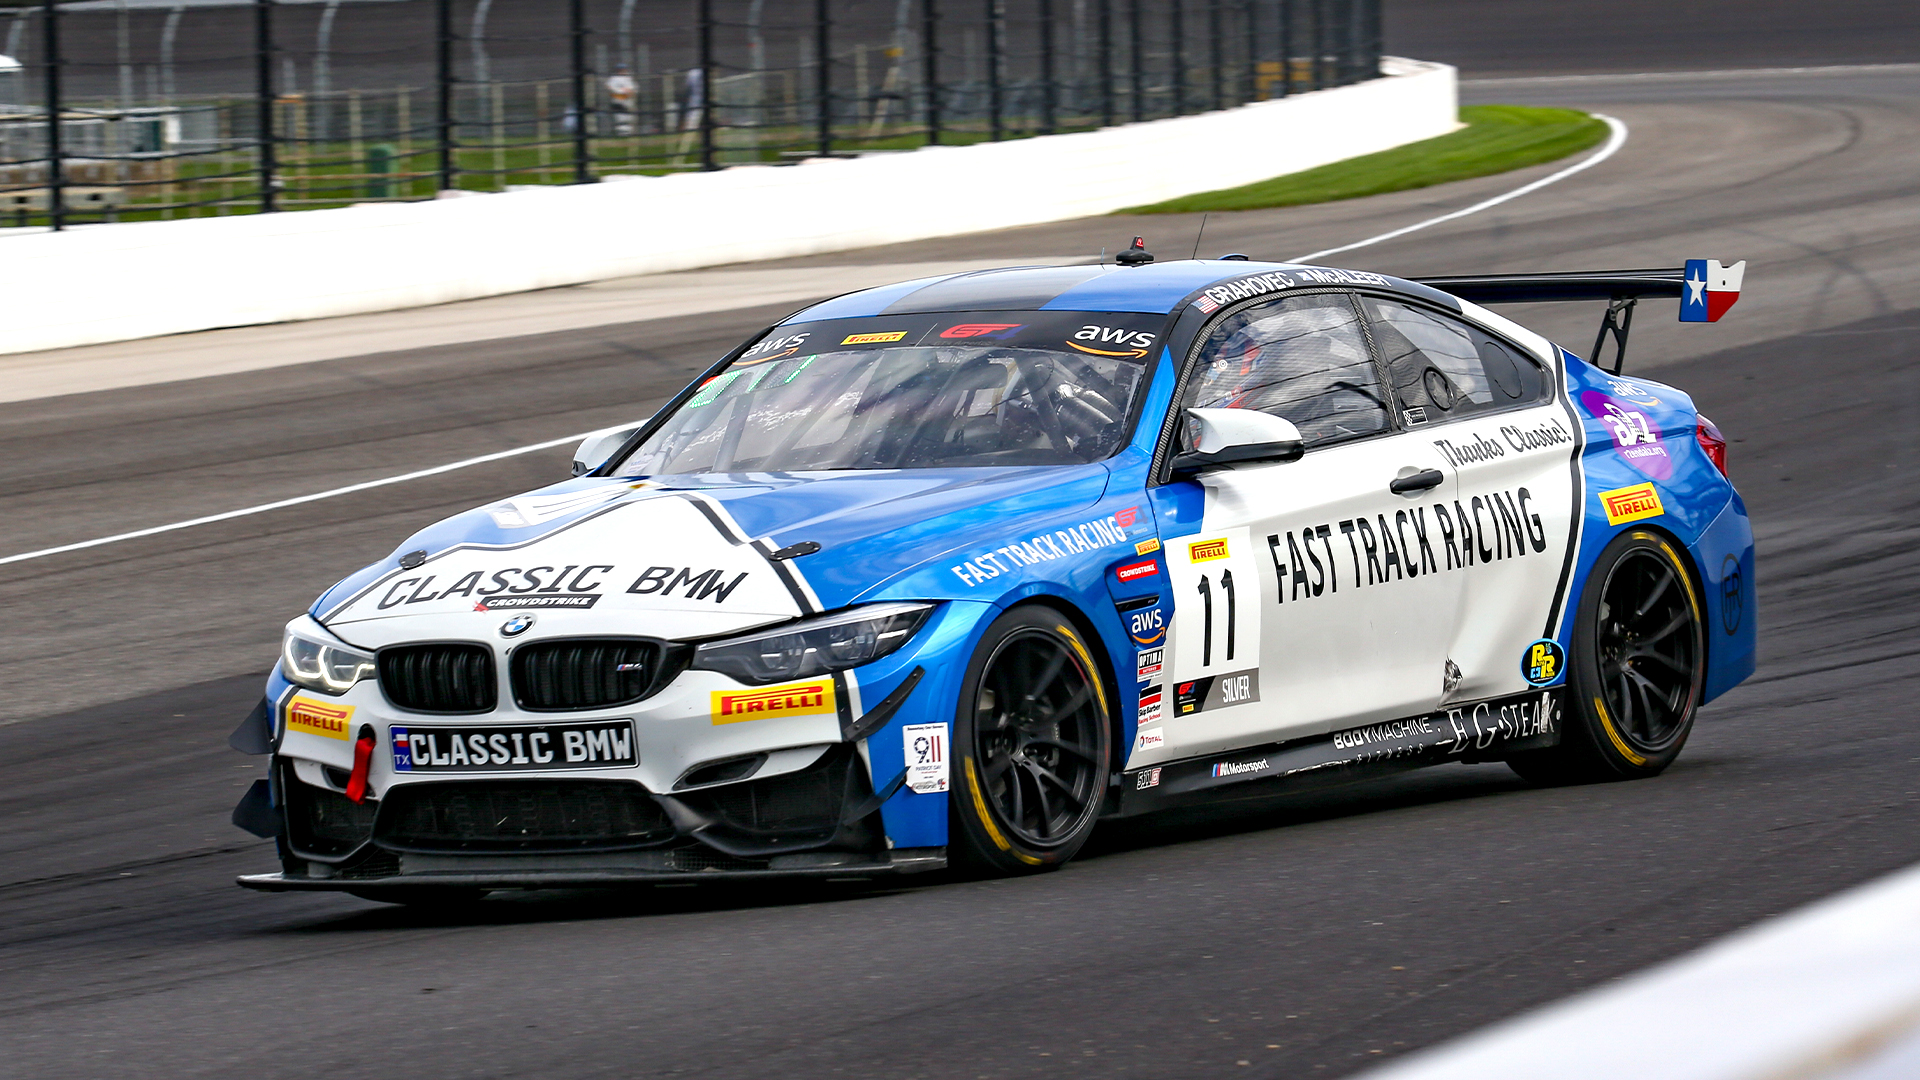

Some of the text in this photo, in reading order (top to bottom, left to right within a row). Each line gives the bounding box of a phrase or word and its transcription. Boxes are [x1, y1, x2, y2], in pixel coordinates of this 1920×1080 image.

[1204, 271, 1295, 304] GRAHOVEC
[1306, 269, 1391, 287] McALEER
[741, 332, 811, 358] aws
[848, 333, 900, 343] PIRELLI
[1074, 325, 1156, 348] aws
[1607, 381, 1647, 396] aws
[1433, 418, 1572, 467] Thanks Classic!
[1606, 489, 1657, 517] PIRELLI
[951, 516, 1127, 587] FAST TRACK RACING
[1192, 541, 1226, 560] PIRELLI
[1267, 487, 1547, 604] FAST TRACK RACING
[1120, 564, 1155, 578] CROWDSTRIKE
[377, 565, 749, 610] CLASSIC BMW
[487, 597, 591, 607] CROWDSTRIKE
[1131, 608, 1163, 633] aws
[1197, 568, 1235, 667] 11
[1140, 650, 1162, 667] OPTIMA
[721, 686, 823, 716] PIRELLI
[1222, 675, 1250, 703] SILVER
[291, 702, 347, 732] PIRELLI
[1333, 717, 1433, 749] BODYMACHINE
[394, 754, 410, 766] TX
[409, 728, 630, 766] CLASSIC BMW
[1229, 758, 1270, 773] Motorsport
